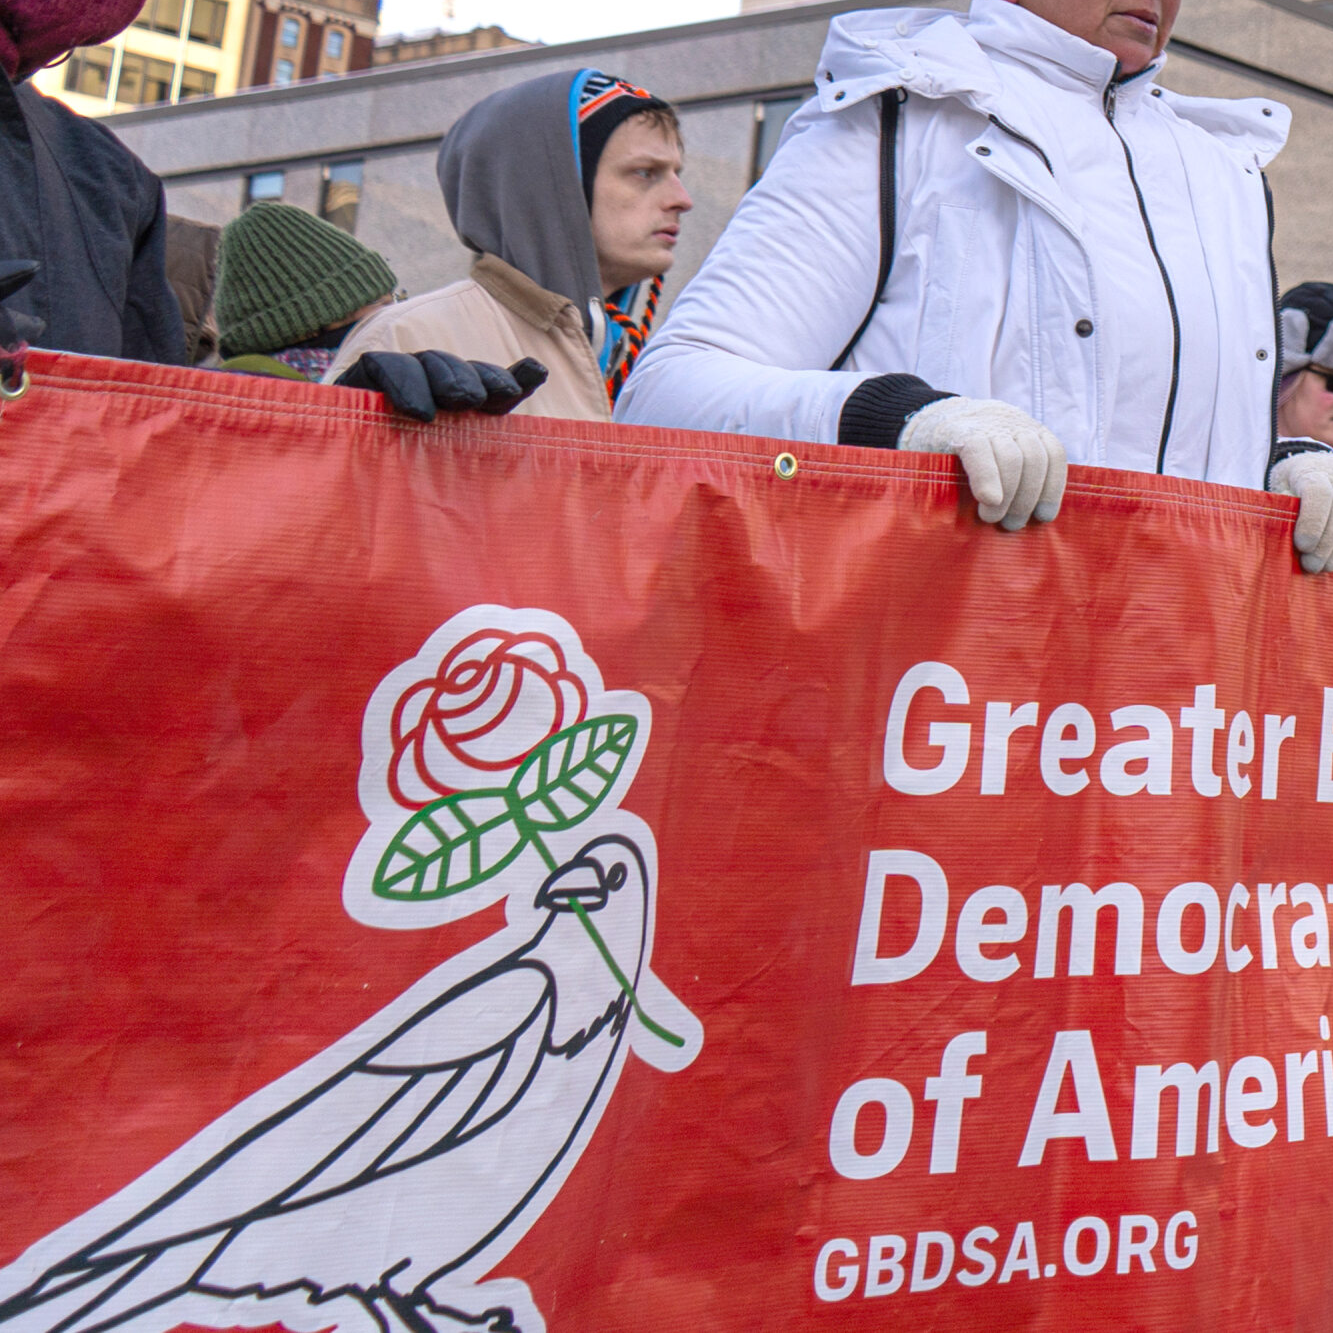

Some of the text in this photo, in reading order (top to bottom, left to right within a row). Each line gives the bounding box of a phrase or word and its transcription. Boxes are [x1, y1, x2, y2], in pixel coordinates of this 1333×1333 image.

[882, 660, 1297, 800] Greater
[828, 1031, 987, 1180] of
[813, 1210, 1199, 1303] GBDSA.ORG
